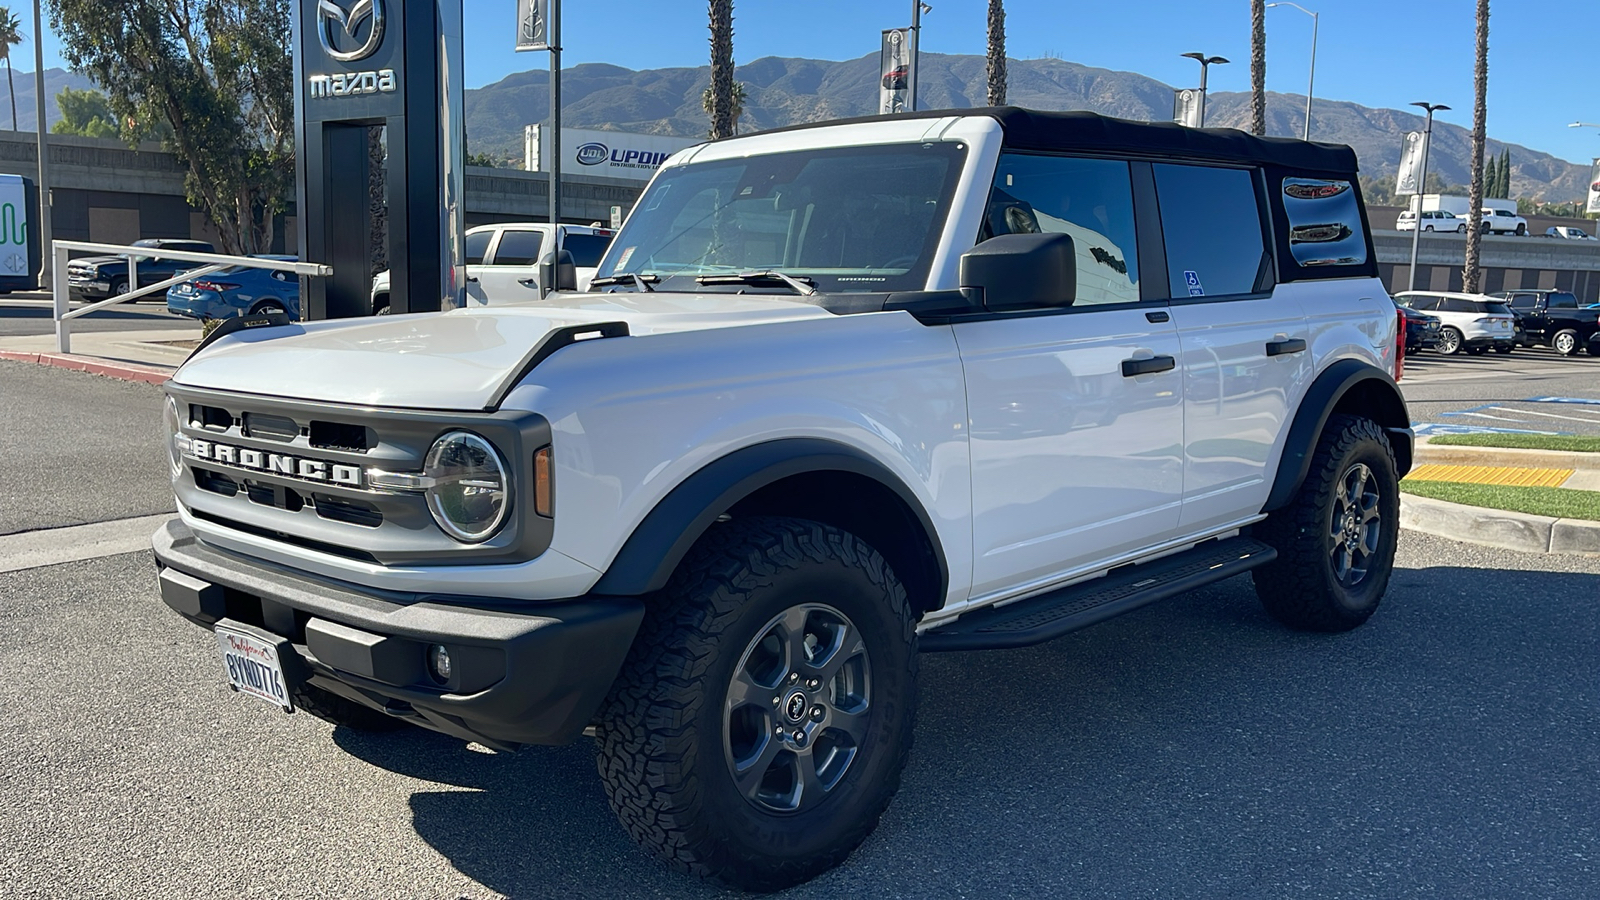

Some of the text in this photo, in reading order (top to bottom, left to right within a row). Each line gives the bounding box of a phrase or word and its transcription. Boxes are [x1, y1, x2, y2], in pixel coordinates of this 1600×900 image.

[308, 69, 397, 99] mazda
[192, 439, 362, 485] BRONCO
[226, 653, 285, 700] 8YND776
